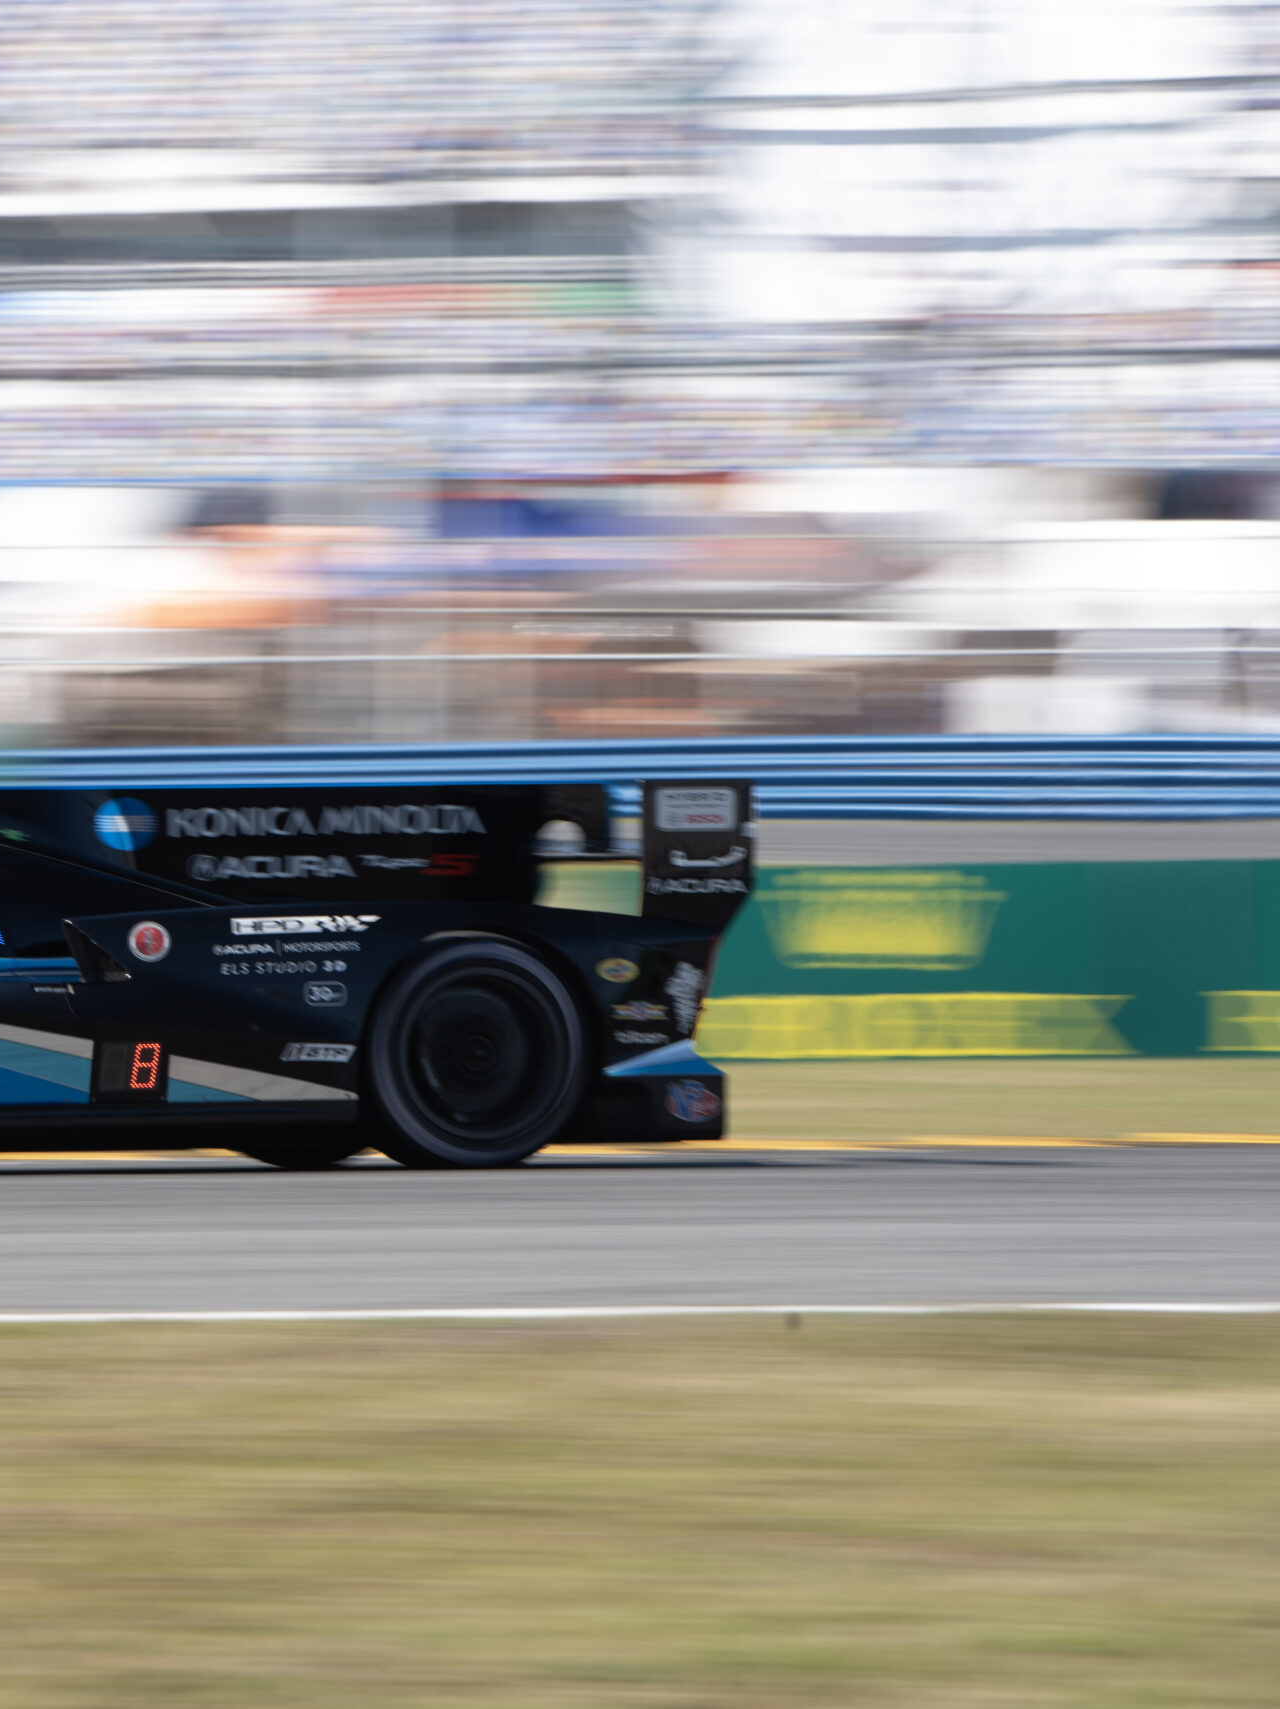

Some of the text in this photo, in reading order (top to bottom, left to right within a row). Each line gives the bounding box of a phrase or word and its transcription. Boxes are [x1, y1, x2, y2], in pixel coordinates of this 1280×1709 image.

[166, 804, 488, 837] KONICA MINOLTA
[219, 854, 358, 879] ACURA
[663, 877, 749, 894] ACURA
[224, 944, 275, 955] ACURA
[220, 962, 250, 975] ELS
[254, 961, 318, 975] STUDIO
